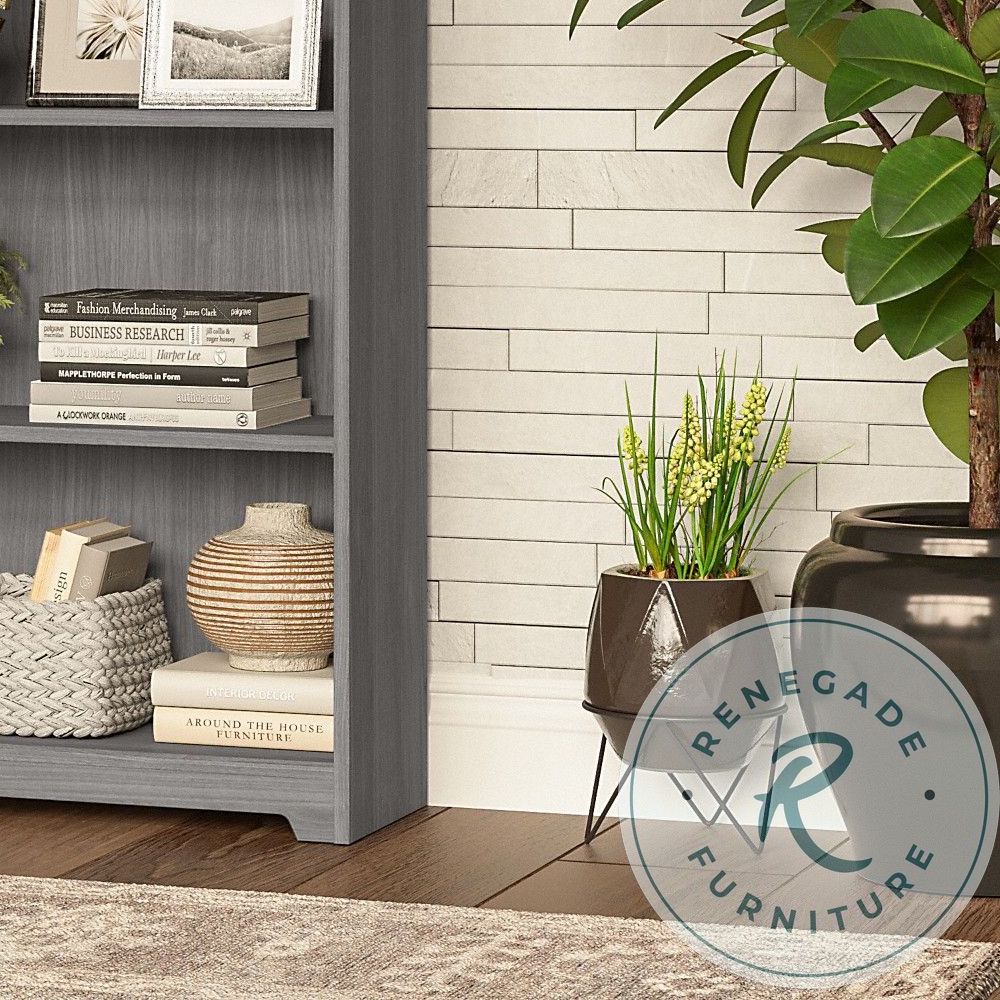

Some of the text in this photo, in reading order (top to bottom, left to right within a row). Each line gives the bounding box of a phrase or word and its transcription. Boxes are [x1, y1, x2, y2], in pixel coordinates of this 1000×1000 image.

[76, 301, 178, 320] Fashion Merchandising
[183, 307, 217, 318] James Clark
[70, 325, 185, 341] BUSINESS RESEARCH
[157, 349, 201, 363] Harper Lee
[58, 370, 116, 379] MAPPLETHORPE
[117, 372, 153, 380] Perfection
[162, 373, 181, 381] Form
[207, 393, 232, 405] name
[101, 412, 126, 420] ORANGE
[206, 687, 296, 702] INTERIOR DECOR
[186, 717, 324, 734] AROUND THE HOUSE
[217, 730, 293, 743] FURNITURE
